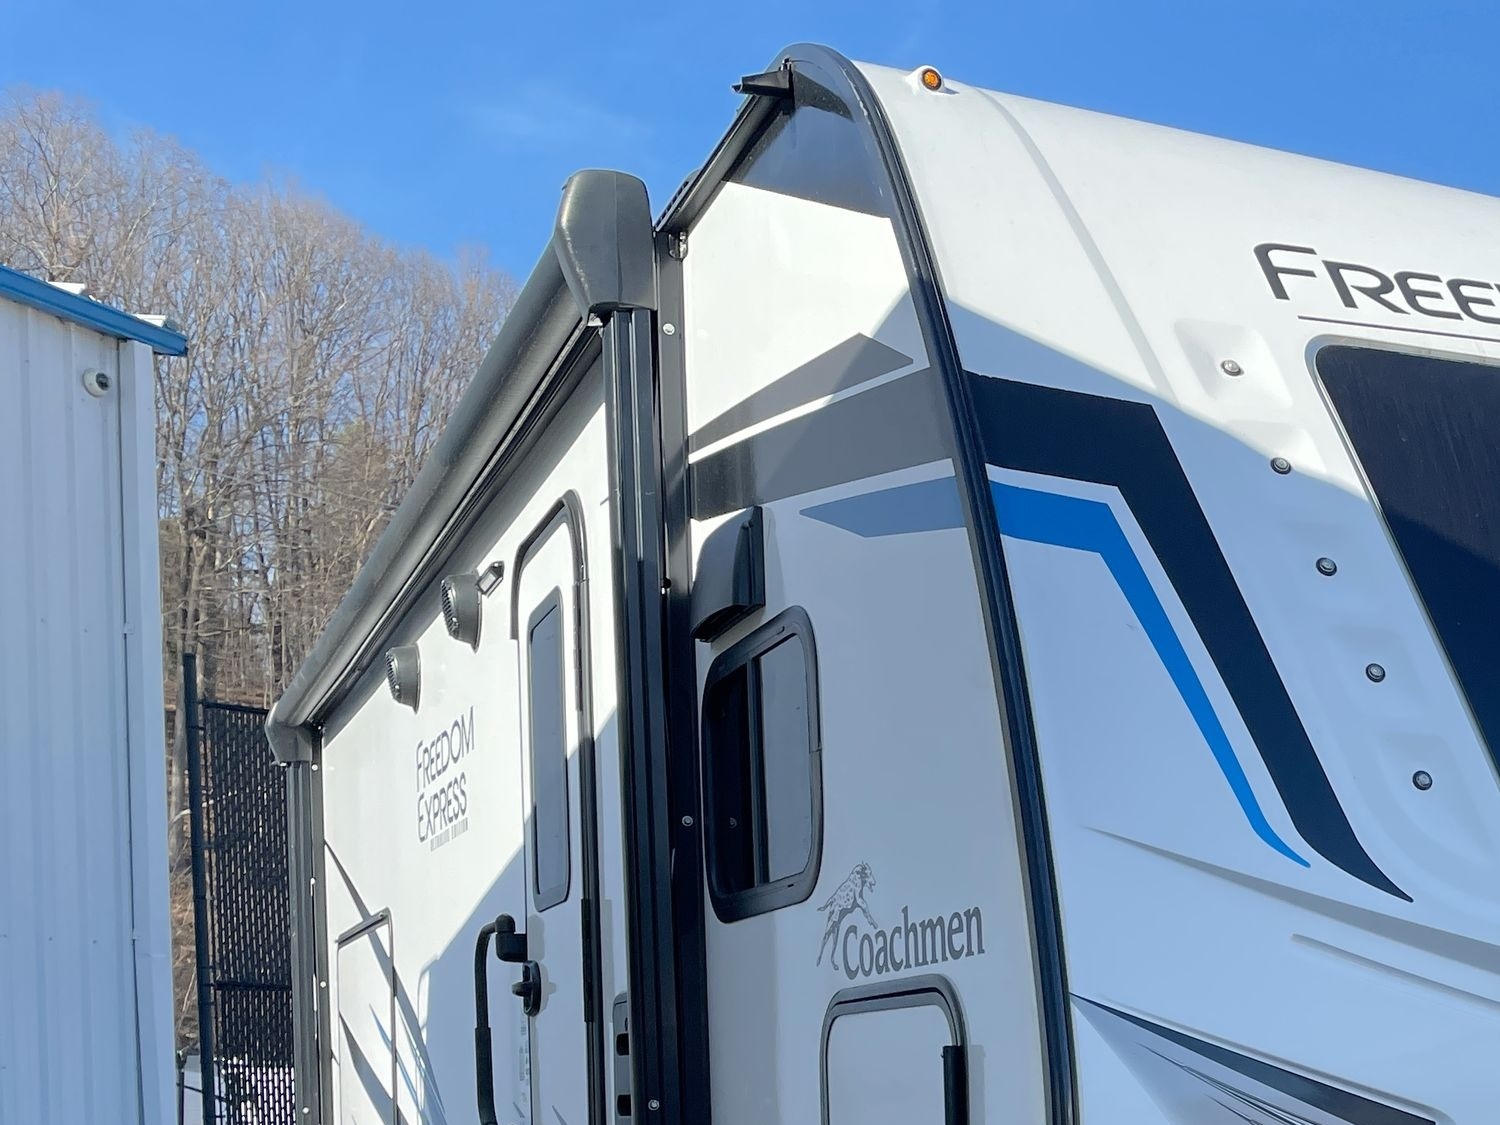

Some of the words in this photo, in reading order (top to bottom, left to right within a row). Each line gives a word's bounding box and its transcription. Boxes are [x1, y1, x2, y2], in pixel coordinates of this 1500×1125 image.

[416, 705, 475, 793] FREEDOM
[417, 771, 468, 843] EXPRESS
[842, 905, 985, 980] Coachmen
